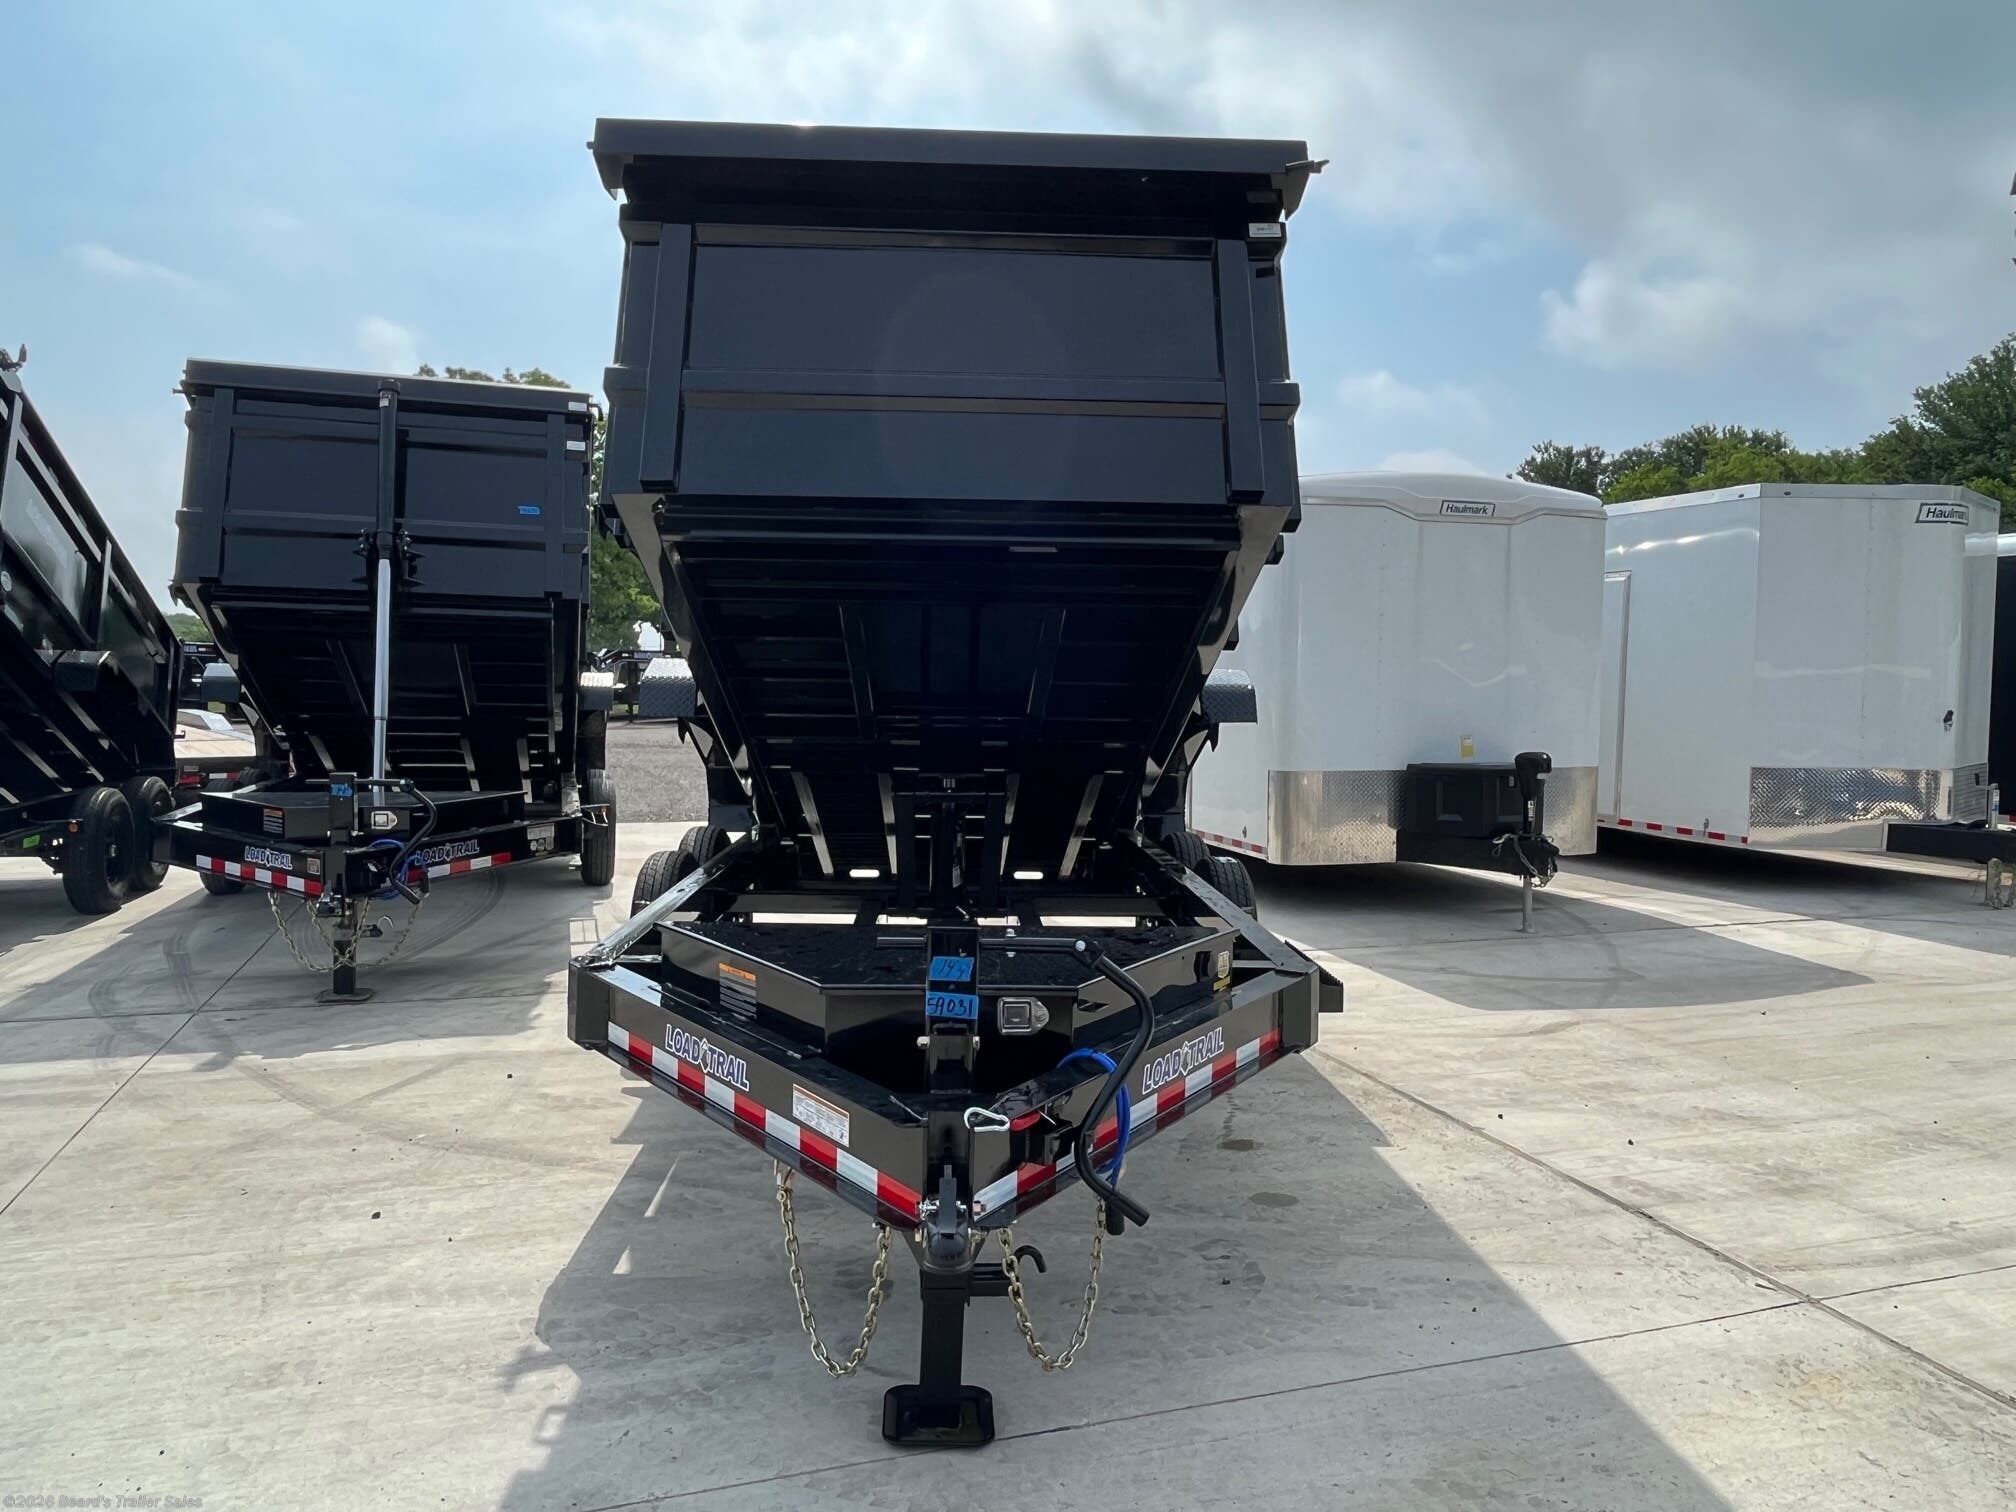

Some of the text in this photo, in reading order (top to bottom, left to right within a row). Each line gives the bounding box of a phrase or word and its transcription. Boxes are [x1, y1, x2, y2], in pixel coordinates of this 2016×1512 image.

[1446, 503, 1488, 515] Haulmark
[244, 845, 266, 864] LOAD
[269, 850, 293, 870] TRAIL
[451, 839, 480, 859] TRAIL
[665, 1023, 750, 1092] LOAD TRAIL
[1142, 1027, 1224, 1095] LOAD TRAIL
